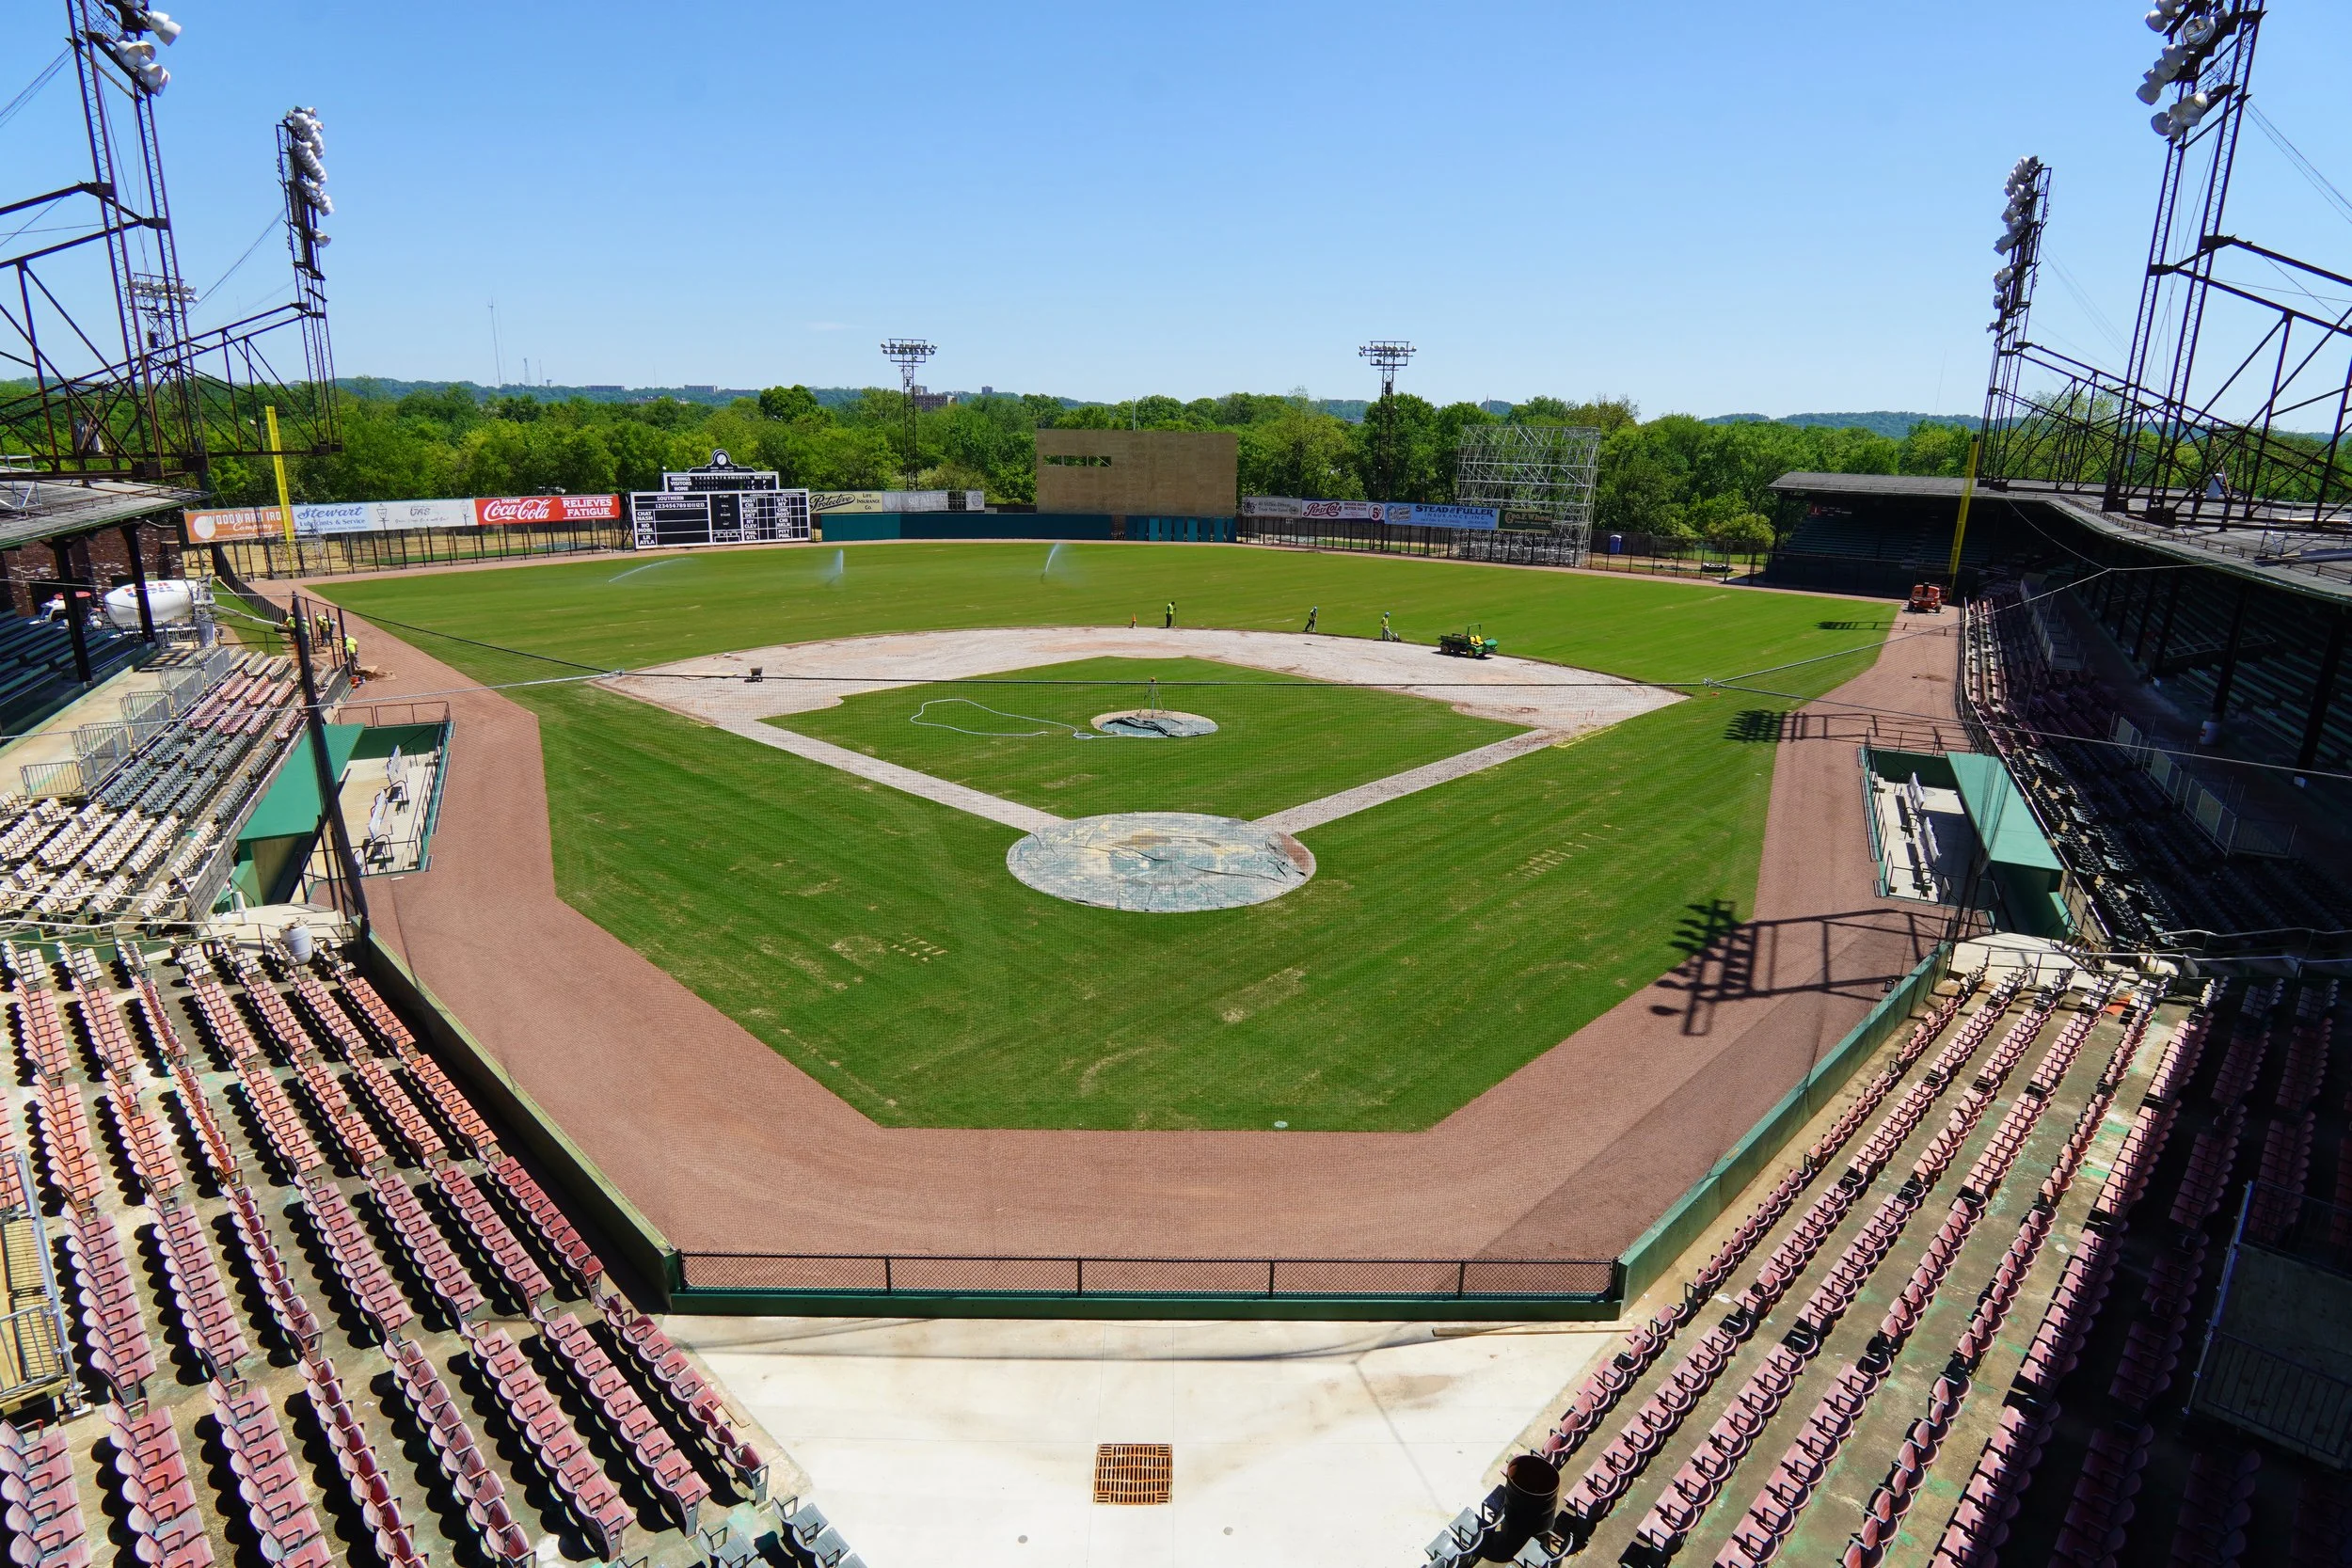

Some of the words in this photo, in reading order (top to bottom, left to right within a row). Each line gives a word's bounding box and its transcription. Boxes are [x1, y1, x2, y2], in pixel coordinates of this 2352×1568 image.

[562, 498, 613, 509] RELIEVES
[809, 493, 856, 512] Protective
[266, 511, 281, 521] IRO
[297, 506, 364, 520] Stewart
[484, 499, 553, 522] Coca-Cola
[566, 507, 611, 517] FATIGUE
[1415, 504, 1449, 514] STEAD
[1455, 507, 1494, 517] FULLER
